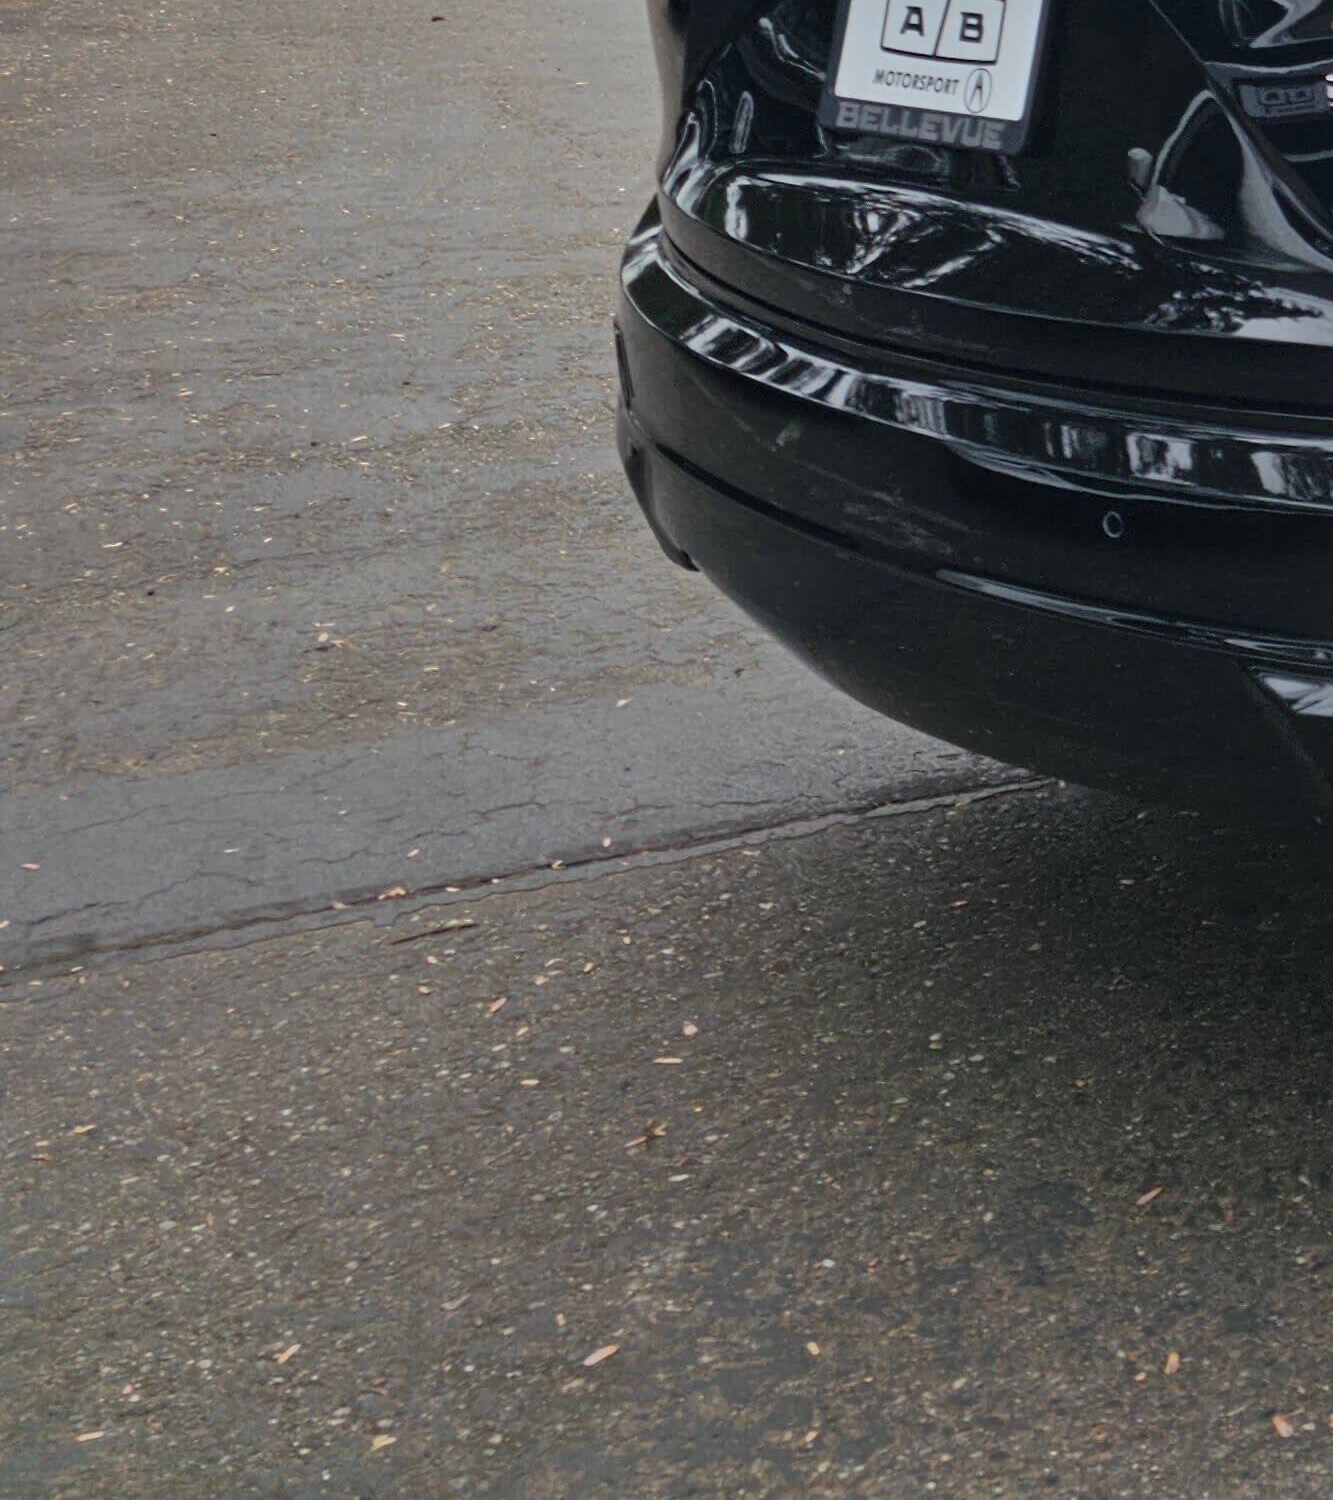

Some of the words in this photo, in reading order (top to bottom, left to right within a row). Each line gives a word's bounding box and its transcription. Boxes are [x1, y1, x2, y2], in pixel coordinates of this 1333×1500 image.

[899, 5, 924, 37] A
[960, 11, 984, 44] B
[872, 68, 960, 96] MOTORSPORT
[835, 102, 1005, 151] BELLEVUE
